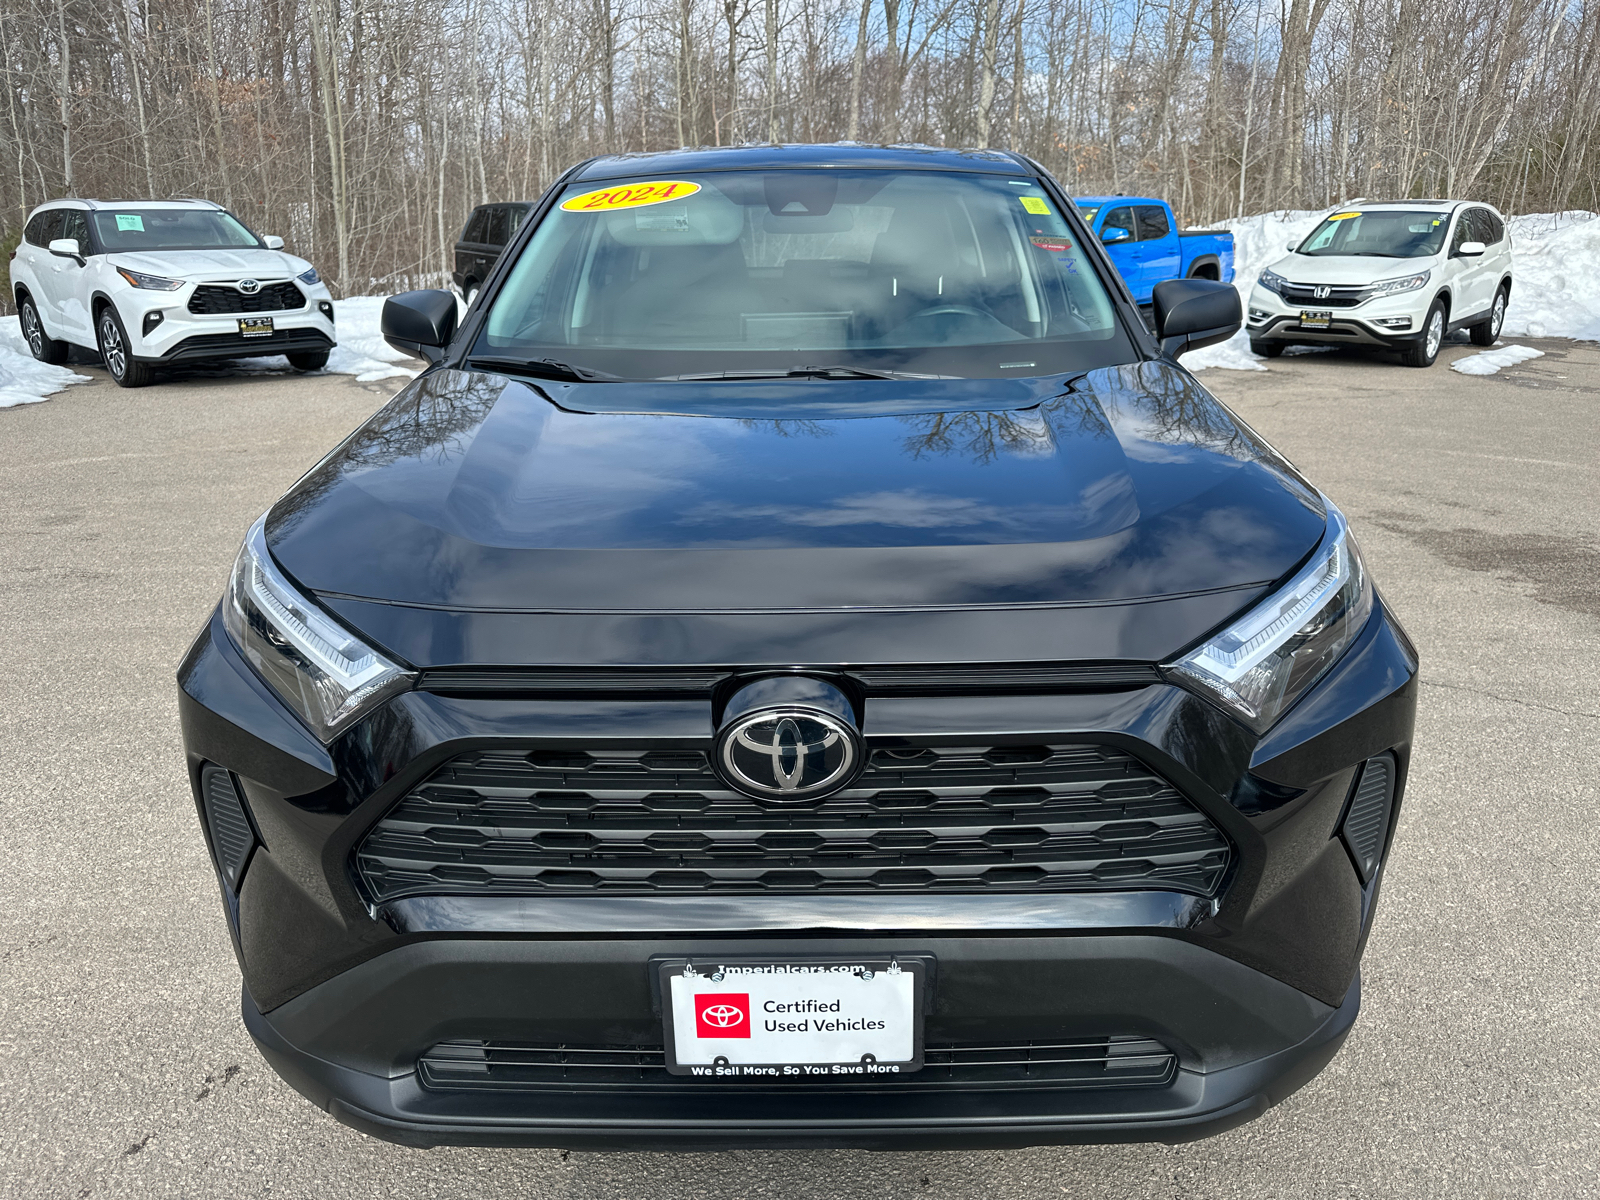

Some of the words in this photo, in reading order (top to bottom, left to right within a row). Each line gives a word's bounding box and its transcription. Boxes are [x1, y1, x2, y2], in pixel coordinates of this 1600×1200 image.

[583, 184, 679, 209] 2024
[718, 964, 866, 975] Imperialcars.com
[763, 999, 841, 1014] Certified
[764, 1019, 809, 1032] Used
[813, 1018, 886, 1032] Vehicles
[691, 1066, 713, 1076] We
[715, 1066, 740, 1076] Sell
[743, 1066, 780, 1077] More,
[783, 1065, 800, 1075] So
[804, 1065, 829, 1075] You
[832, 1065, 864, 1075] Save
[867, 1064, 900, 1074] More
